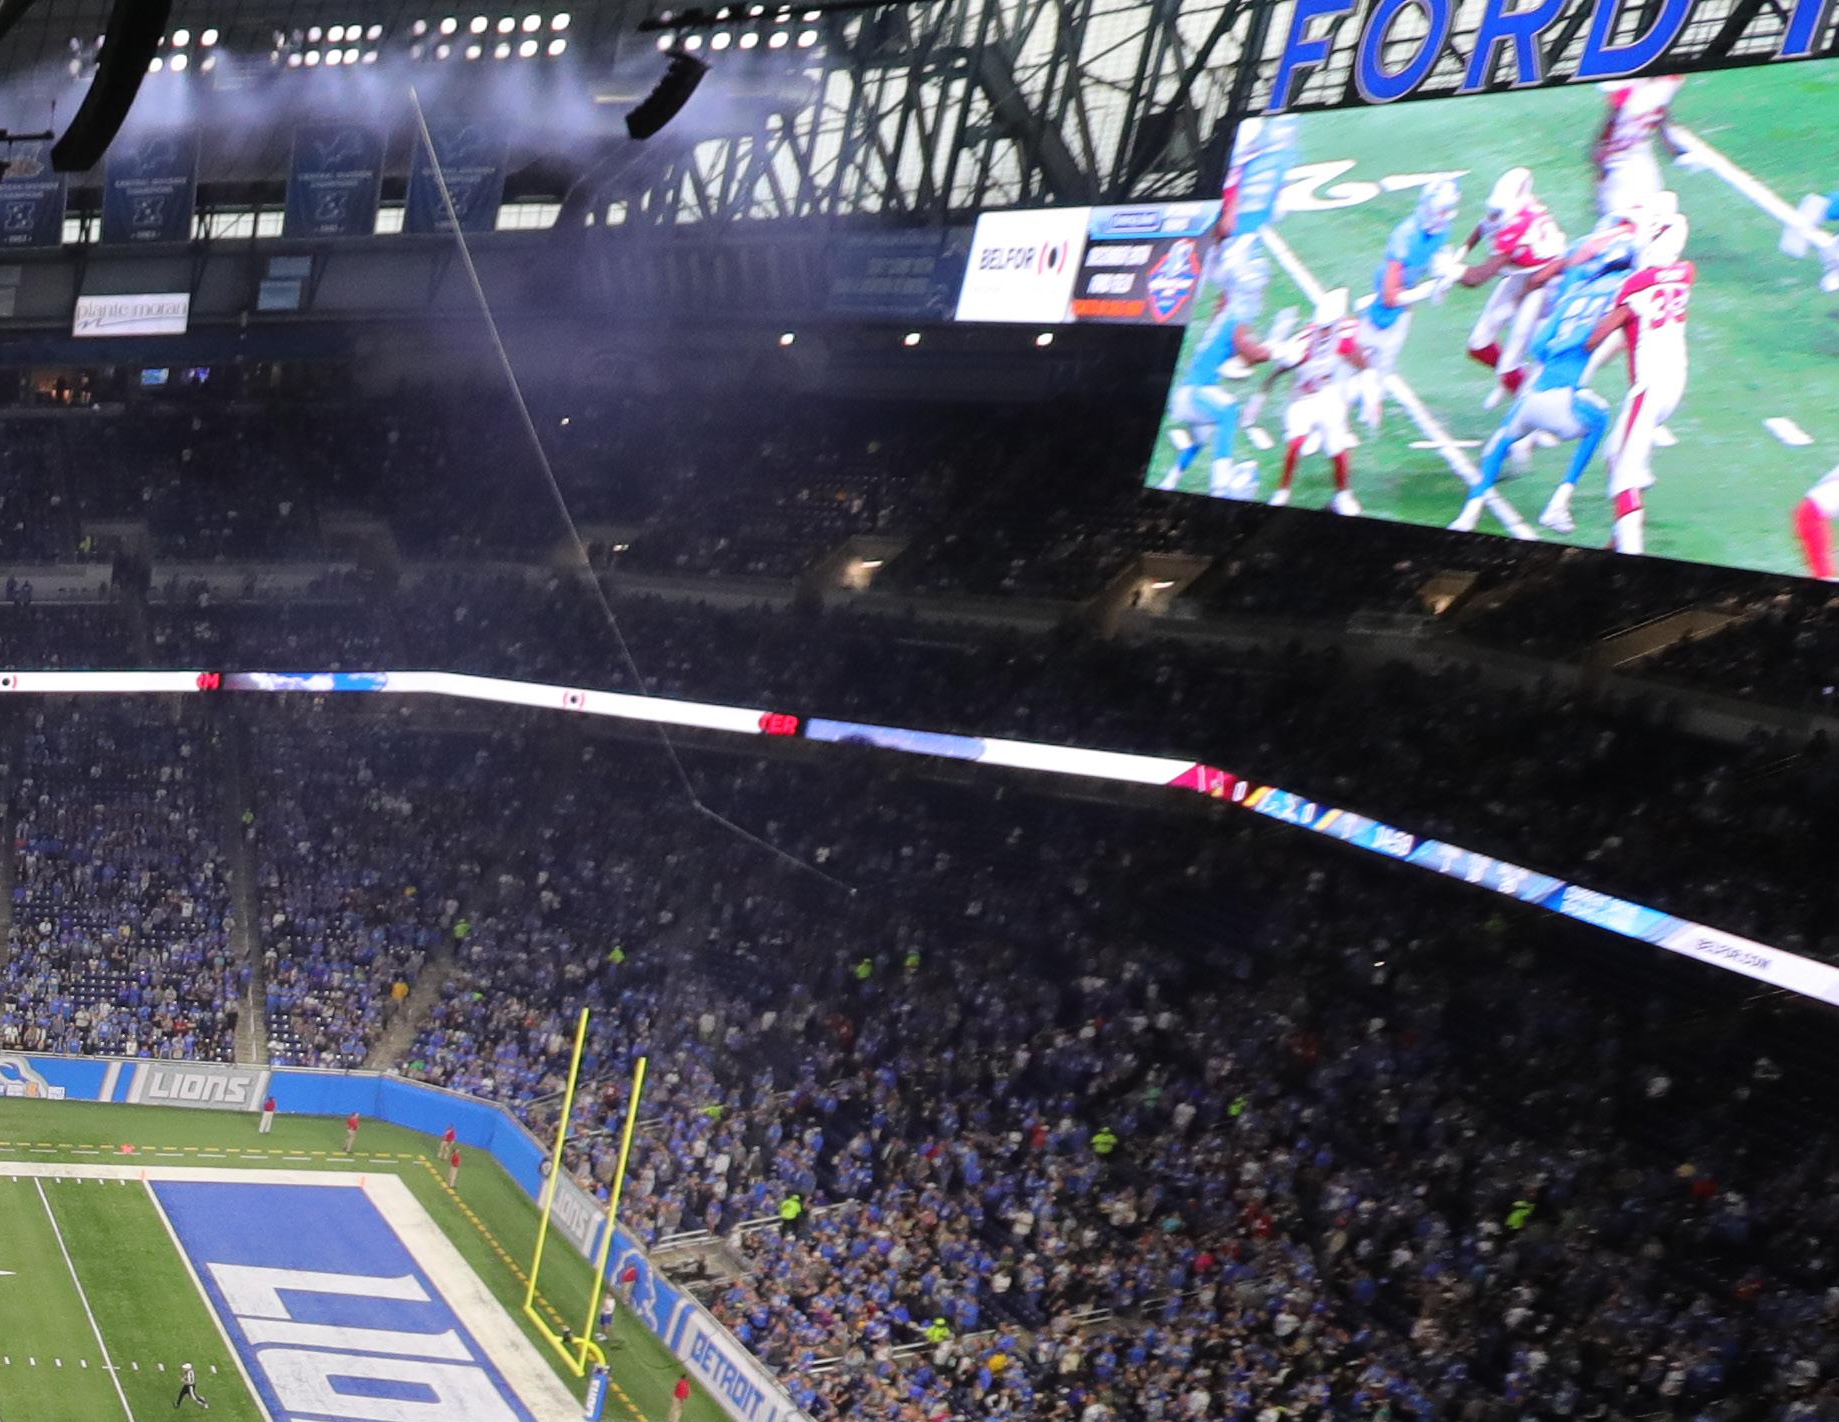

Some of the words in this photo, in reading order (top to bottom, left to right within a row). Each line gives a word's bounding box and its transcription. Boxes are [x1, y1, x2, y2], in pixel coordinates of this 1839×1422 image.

[1267, 0, 1693, 114] FORD
[978, 245, 1034, 271] BELFOR
[148, 1072, 252, 1103] LIONS
[690, 1329, 766, 1422] DETROIT
